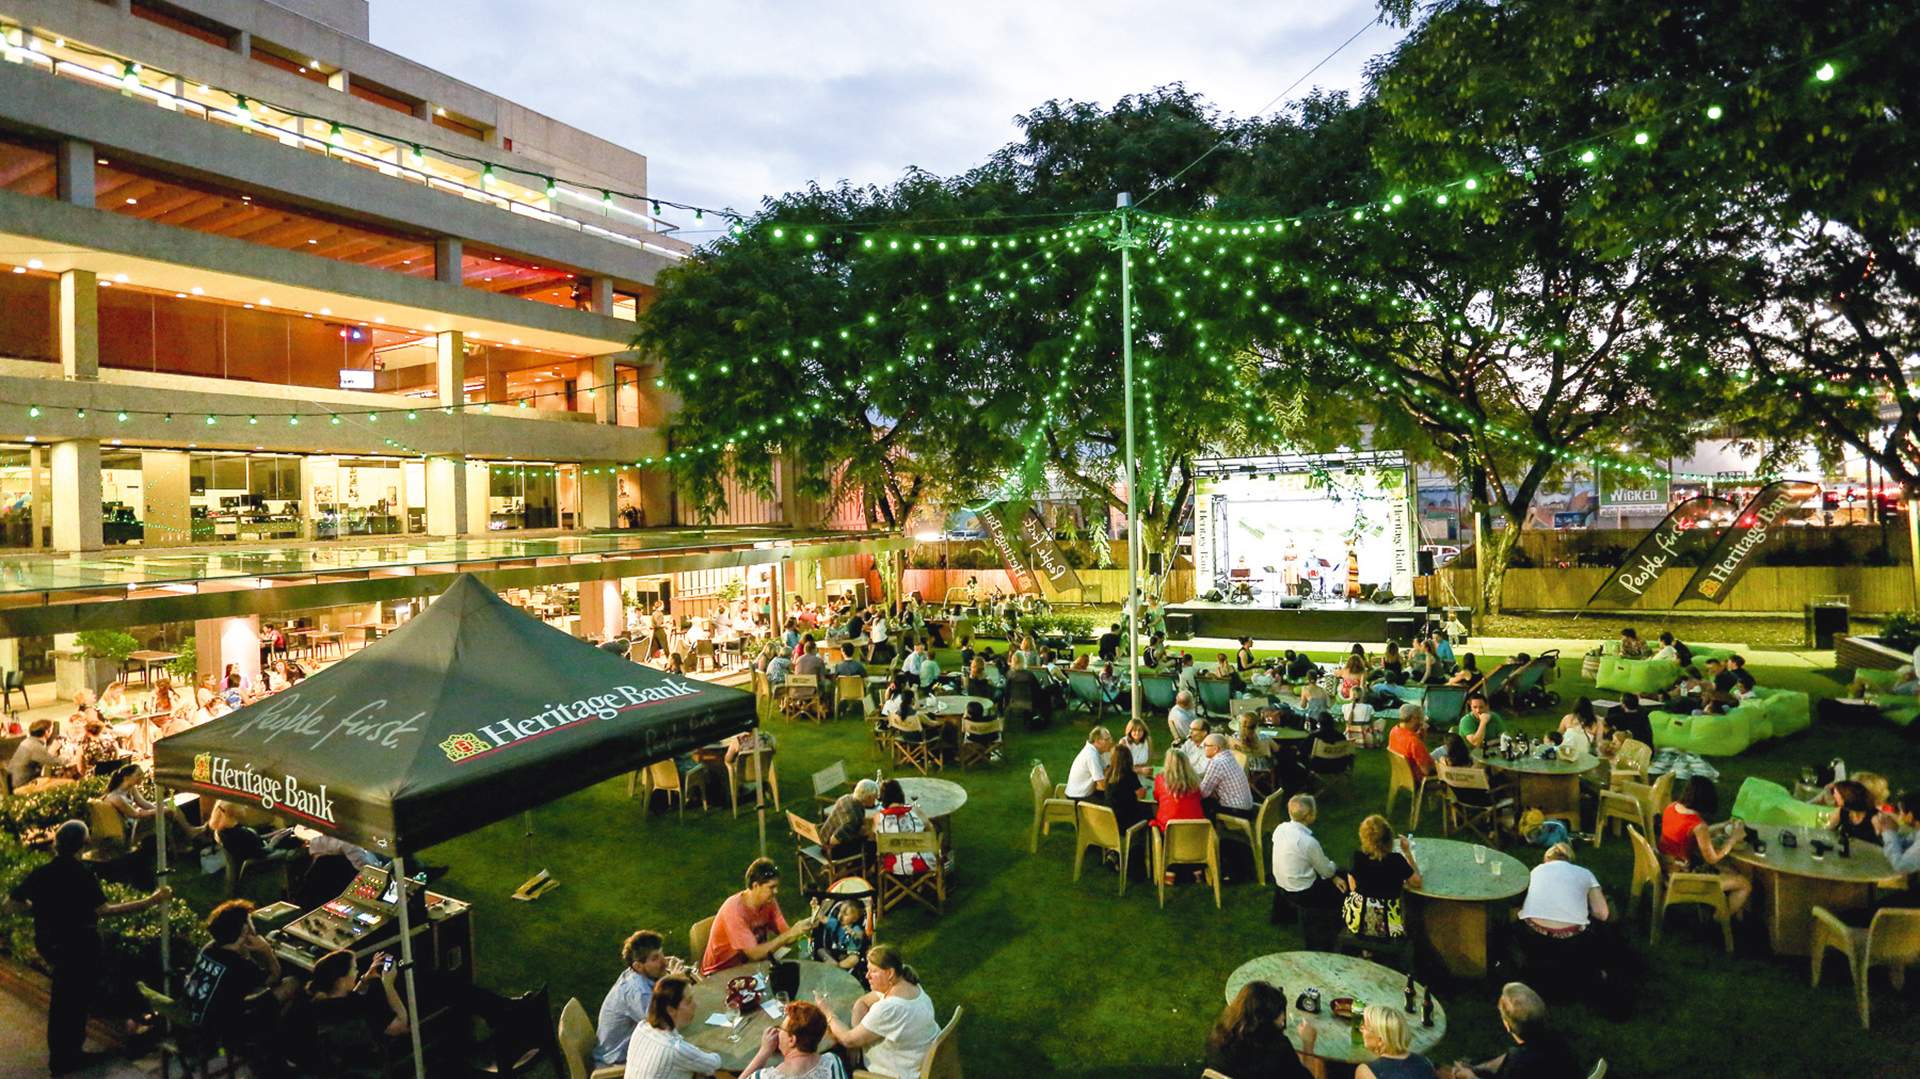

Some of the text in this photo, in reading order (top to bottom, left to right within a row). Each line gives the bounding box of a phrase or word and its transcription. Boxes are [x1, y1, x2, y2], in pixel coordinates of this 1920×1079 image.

[1709, 486, 1792, 583] Heritage Ban
[1619, 555, 1667, 595] People
[232, 694, 336, 744] People
[478, 678, 701, 747] Heritage Bank
[212, 757, 336, 823] Heritage Bank
